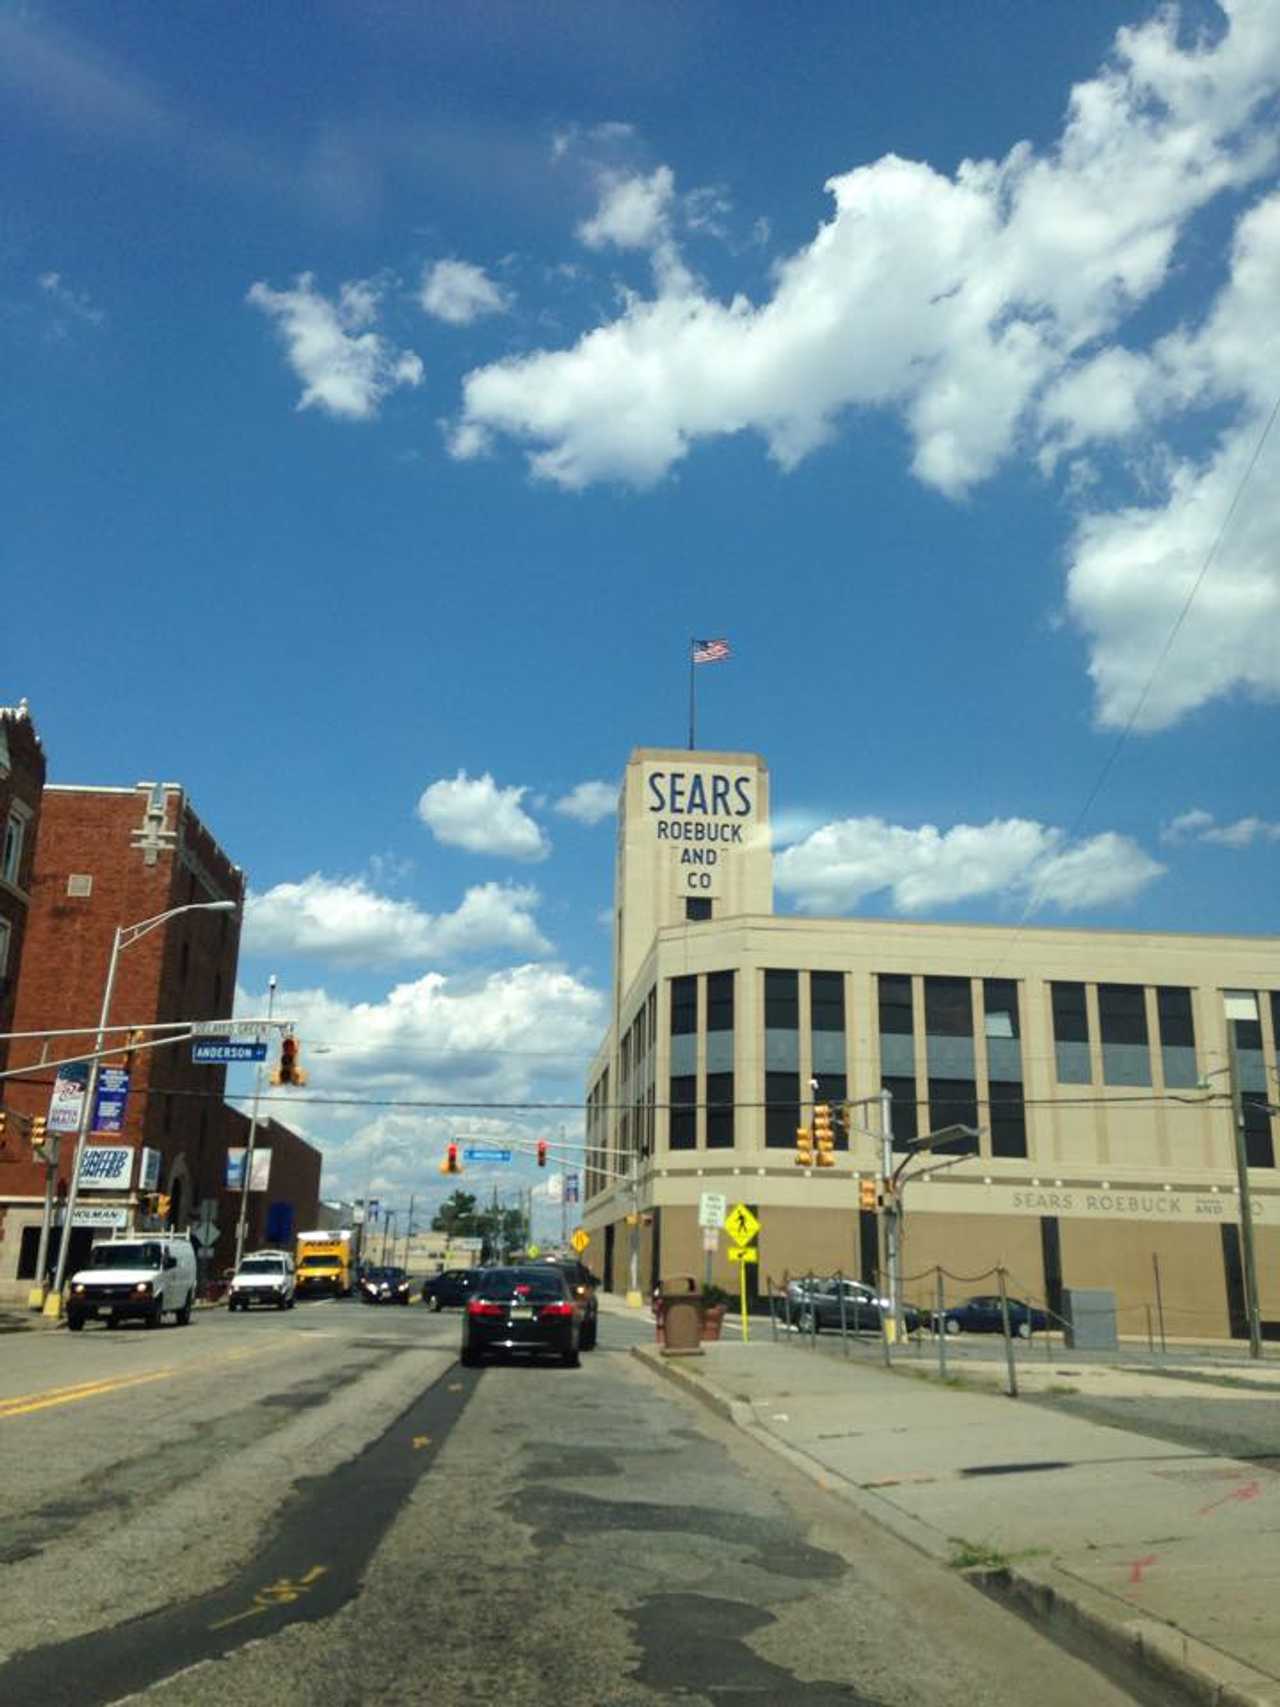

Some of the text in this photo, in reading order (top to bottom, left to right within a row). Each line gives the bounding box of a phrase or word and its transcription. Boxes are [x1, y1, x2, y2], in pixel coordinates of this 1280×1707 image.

[648, 772, 752, 816] SEARS
[657, 820, 743, 842] ROEBUCK
[680, 848, 718, 865] AND
[687, 872, 712, 889] CO
[197, 1046, 252, 1058] ANDERSON
[83, 1150, 128, 1160] UNITED
[82, 1159, 126, 1169] UNITED
[1013, 1193, 1073, 1209] SEARS
[1086, 1195, 1182, 1213] ROEBUCK
[1195, 1204, 1223, 1214] AND
